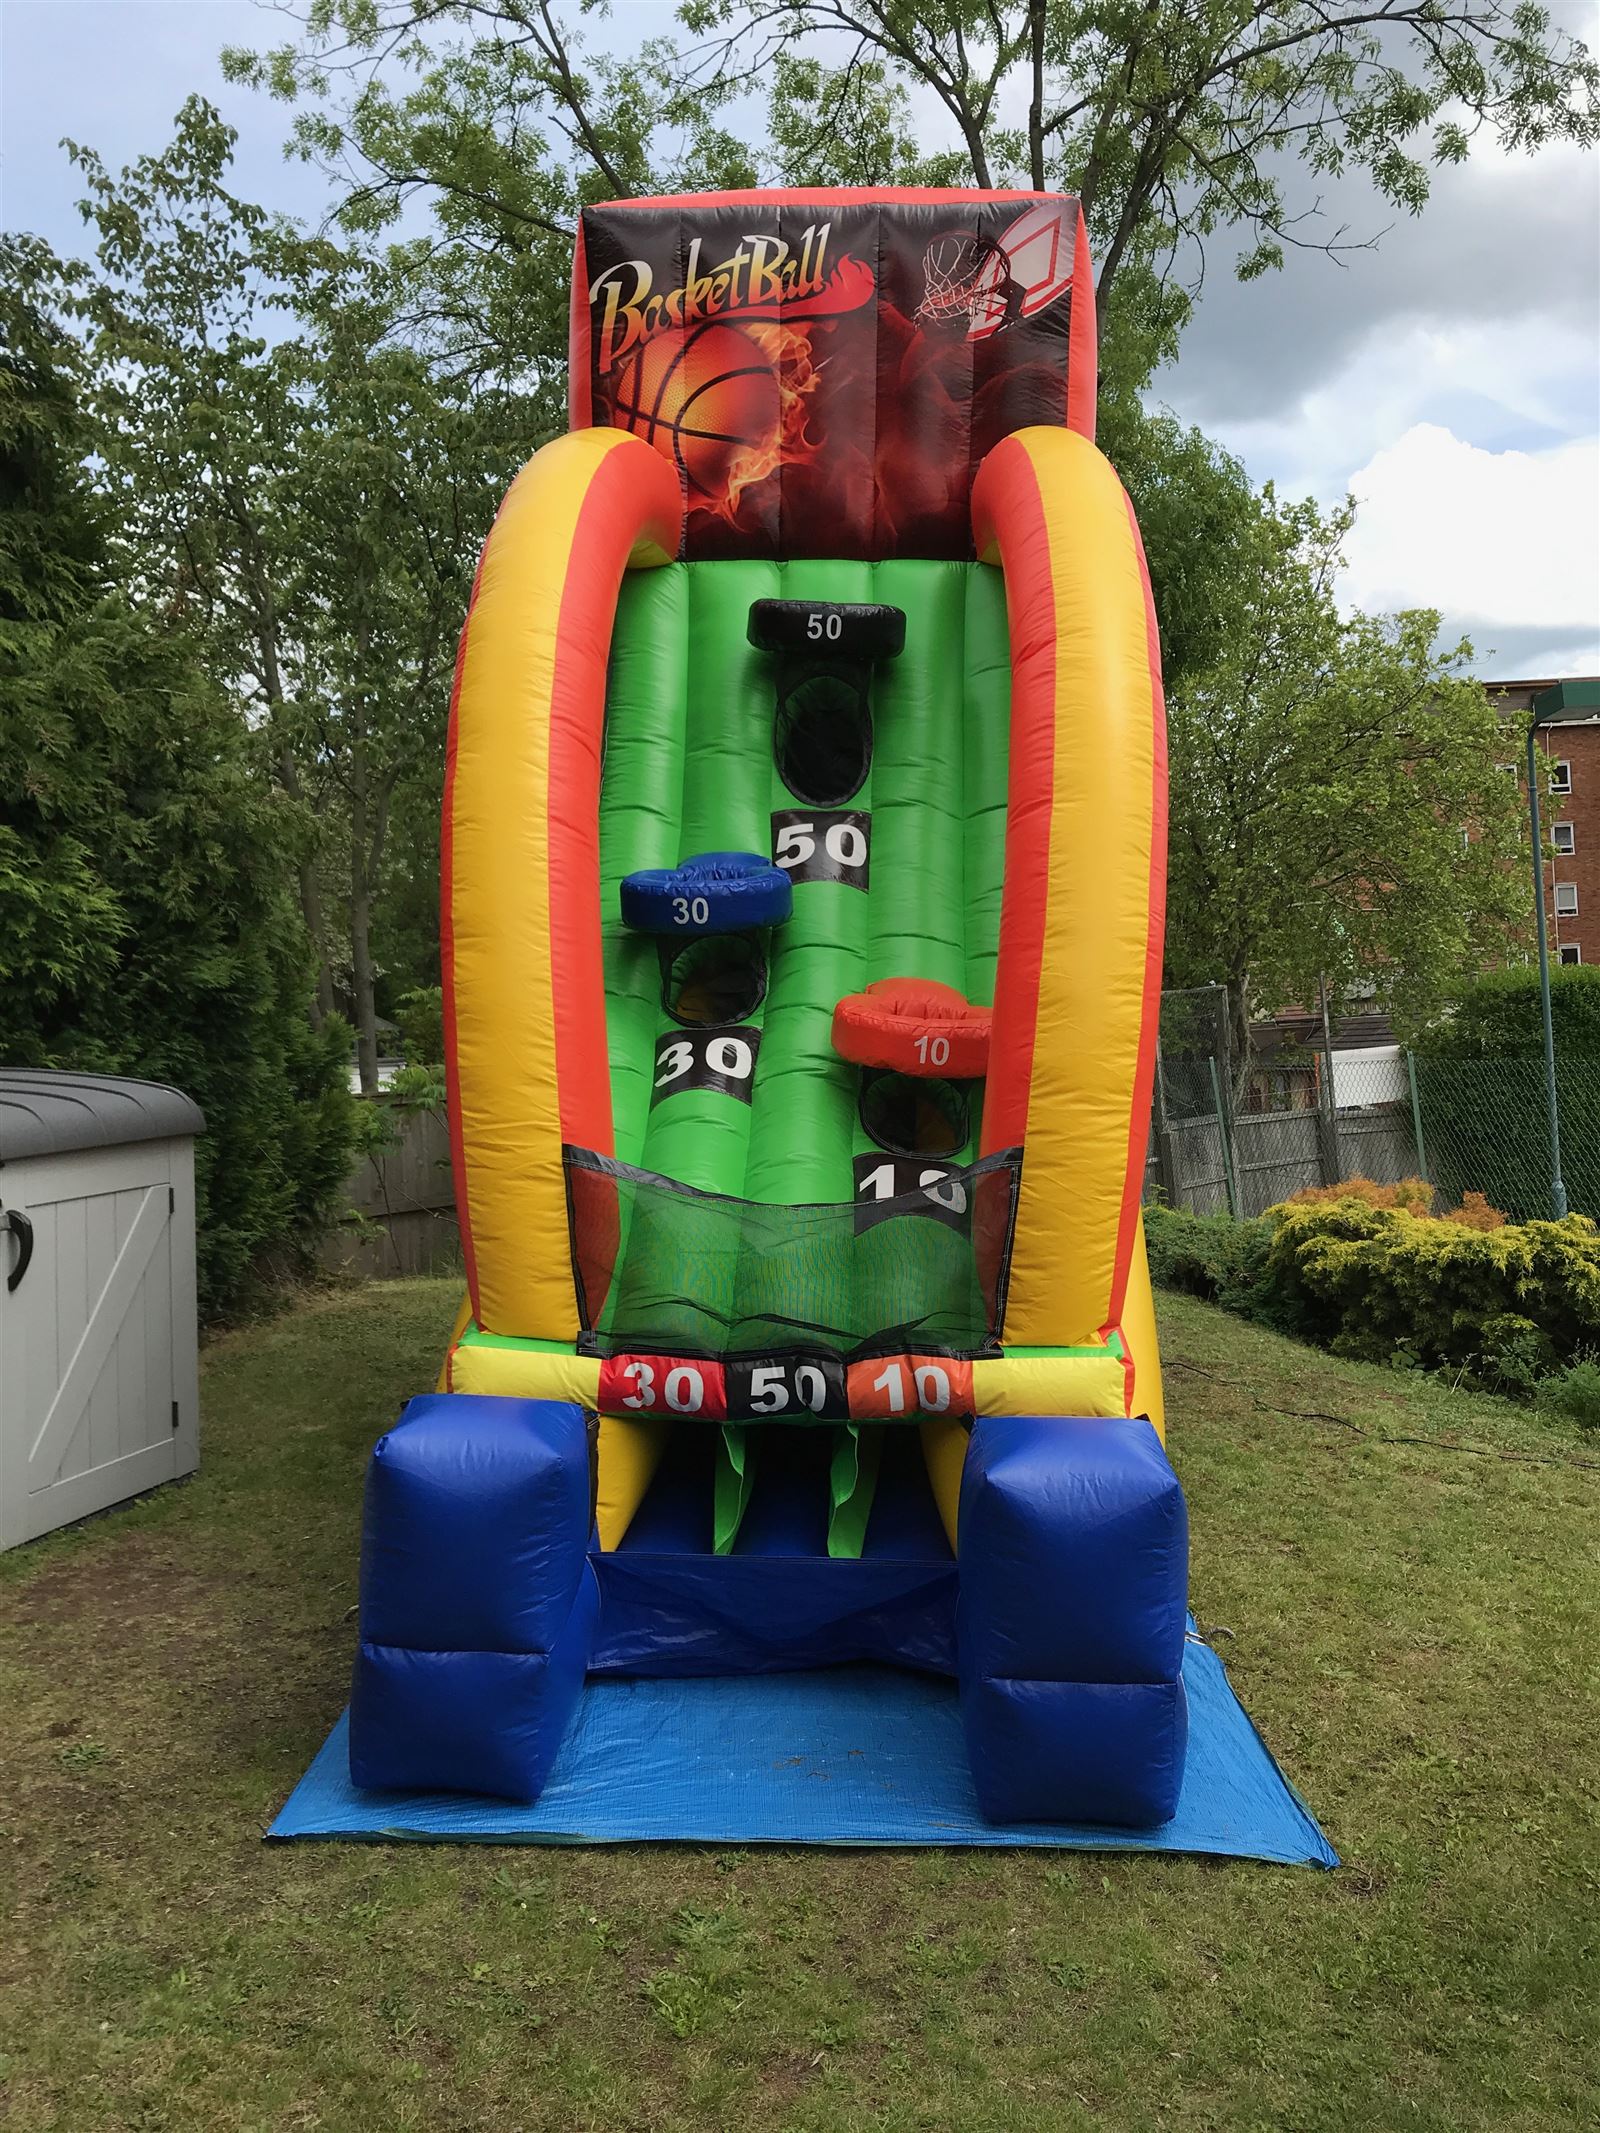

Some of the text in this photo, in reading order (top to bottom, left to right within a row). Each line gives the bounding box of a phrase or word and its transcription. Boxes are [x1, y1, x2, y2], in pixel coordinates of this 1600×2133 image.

[589, 222, 831, 374] BasketBall
[807, 614, 842, 640] 50
[774, 823, 867, 868] 50
[672, 897, 709, 925] 30
[655, 1037, 752, 1087] 30
[913, 1036, 950, 1066] 10
[859, 1164, 967, 1214] 10
[623, 1362, 951, 1412] 30 50 10
